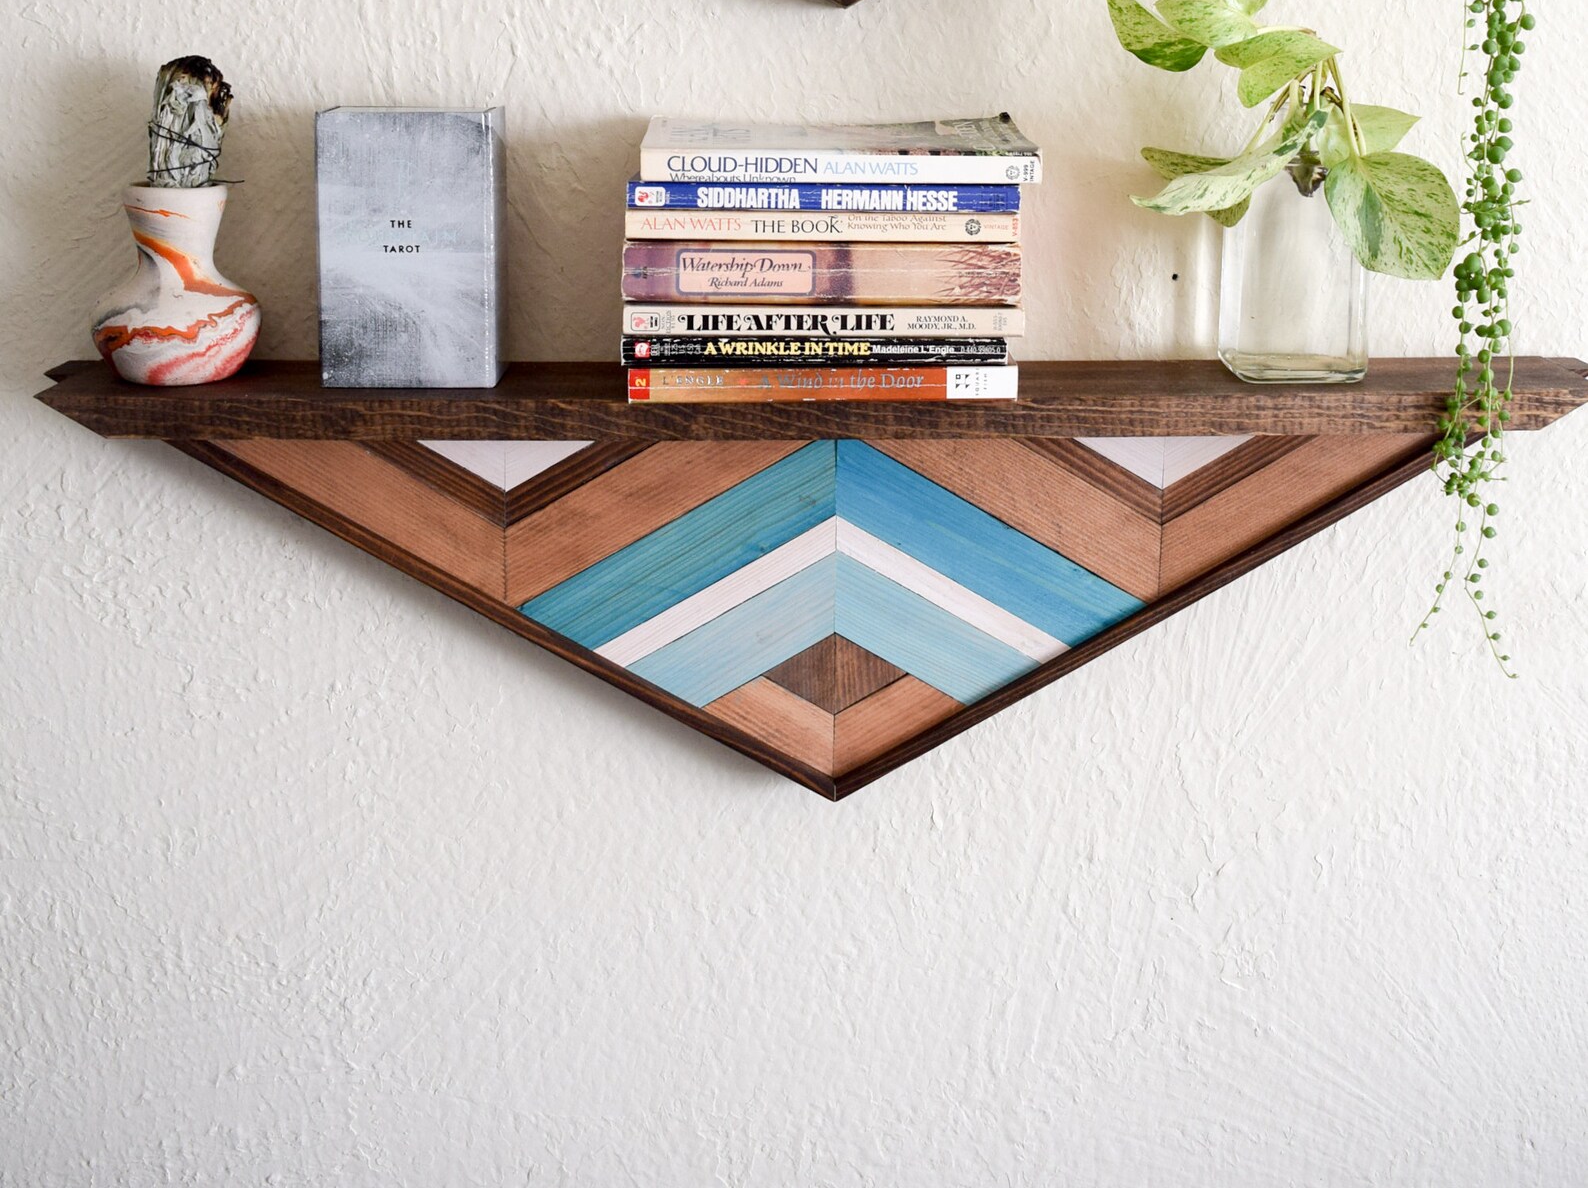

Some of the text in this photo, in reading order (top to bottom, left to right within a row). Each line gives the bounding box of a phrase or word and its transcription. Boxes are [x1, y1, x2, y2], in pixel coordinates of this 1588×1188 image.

[667, 155, 919, 176] CLOUD-HIDDEN ALAN WATTS
[670, 173, 796, 183] Whereabouts Unknown
[697, 187, 800, 209] SIDDHARTHA
[821, 188, 904, 210] HERMANN
[906, 189, 959, 211] HESSE
[389, 220, 412, 228] THE
[847, 214, 862, 222] On
[910, 214, 947, 224] Against
[641, 217, 686, 231] ALAN
[689, 217, 742, 231] WATTS
[750, 219, 786, 233] THE
[847, 222, 947, 232] Knowing Who You Are
[383, 245, 421, 253] TAROT
[681, 256, 811, 279] Watership Down
[708, 276, 783, 289] Richard Adams
[677, 314, 741, 332] LIFE
[743, 314, 838, 336] AFTER
[831, 313, 895, 332] LIFE
[915, 315, 969, 323] RAYMOND A.
[907, 323, 940, 331] MOODY,
[958, 323, 977, 331] M.D.
[704, 341, 871, 356] A WRINKLE IN TIME
[872, 343, 919, 354] Madeleine
[635, 377, 647, 387] 2
[777, 374, 823, 389] Wind
[827, 376, 845, 388] in
[850, 370, 876, 392] the
[880, 373, 925, 389] Door
